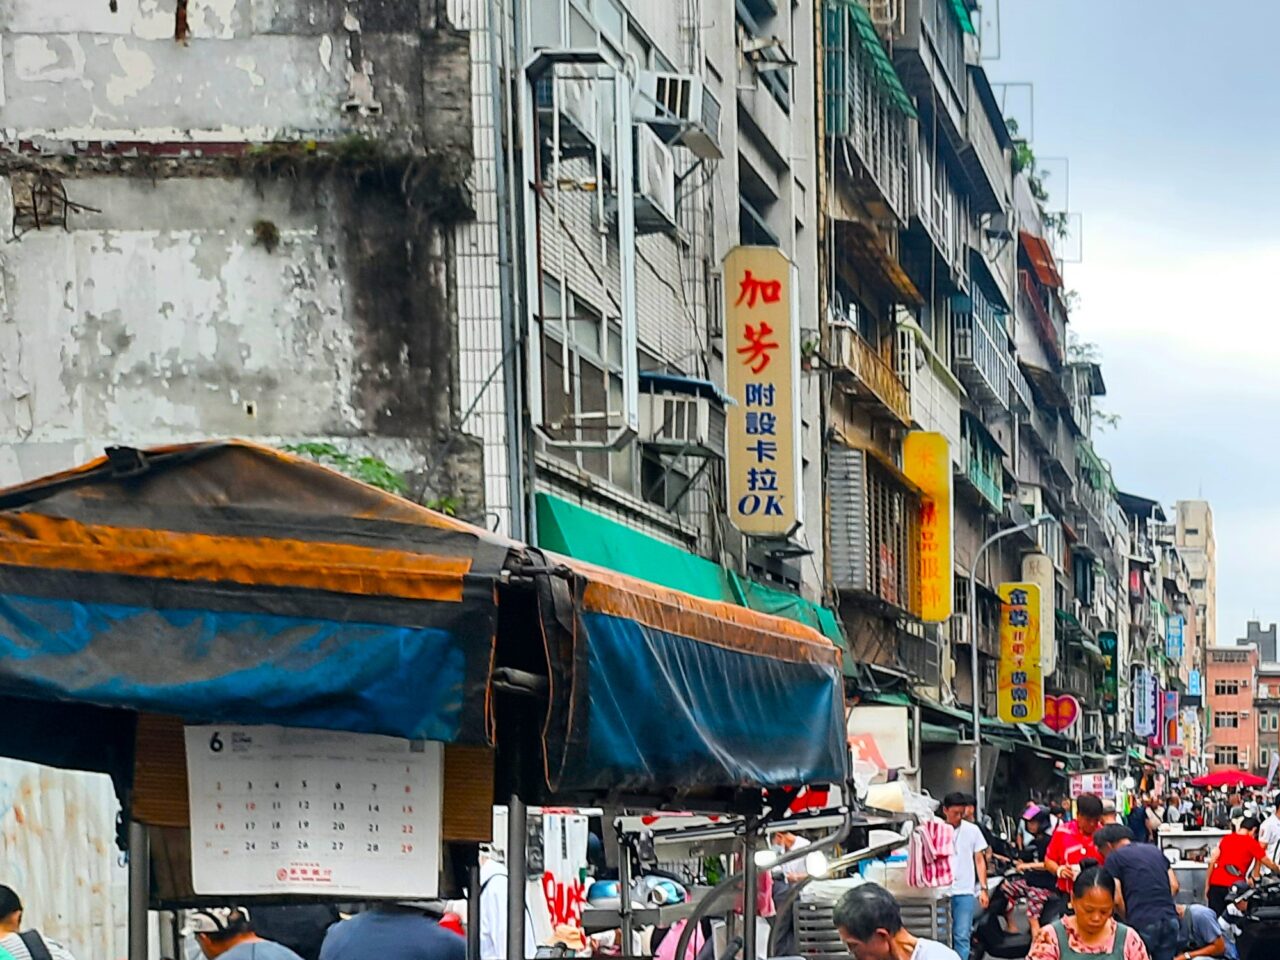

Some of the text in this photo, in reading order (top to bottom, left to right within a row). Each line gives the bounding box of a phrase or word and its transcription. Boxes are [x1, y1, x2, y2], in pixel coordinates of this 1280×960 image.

[735, 269, 782, 375] 加芳
[738, 382, 784, 517] 附設卡拉OK
[209, 731, 224, 753] 6
